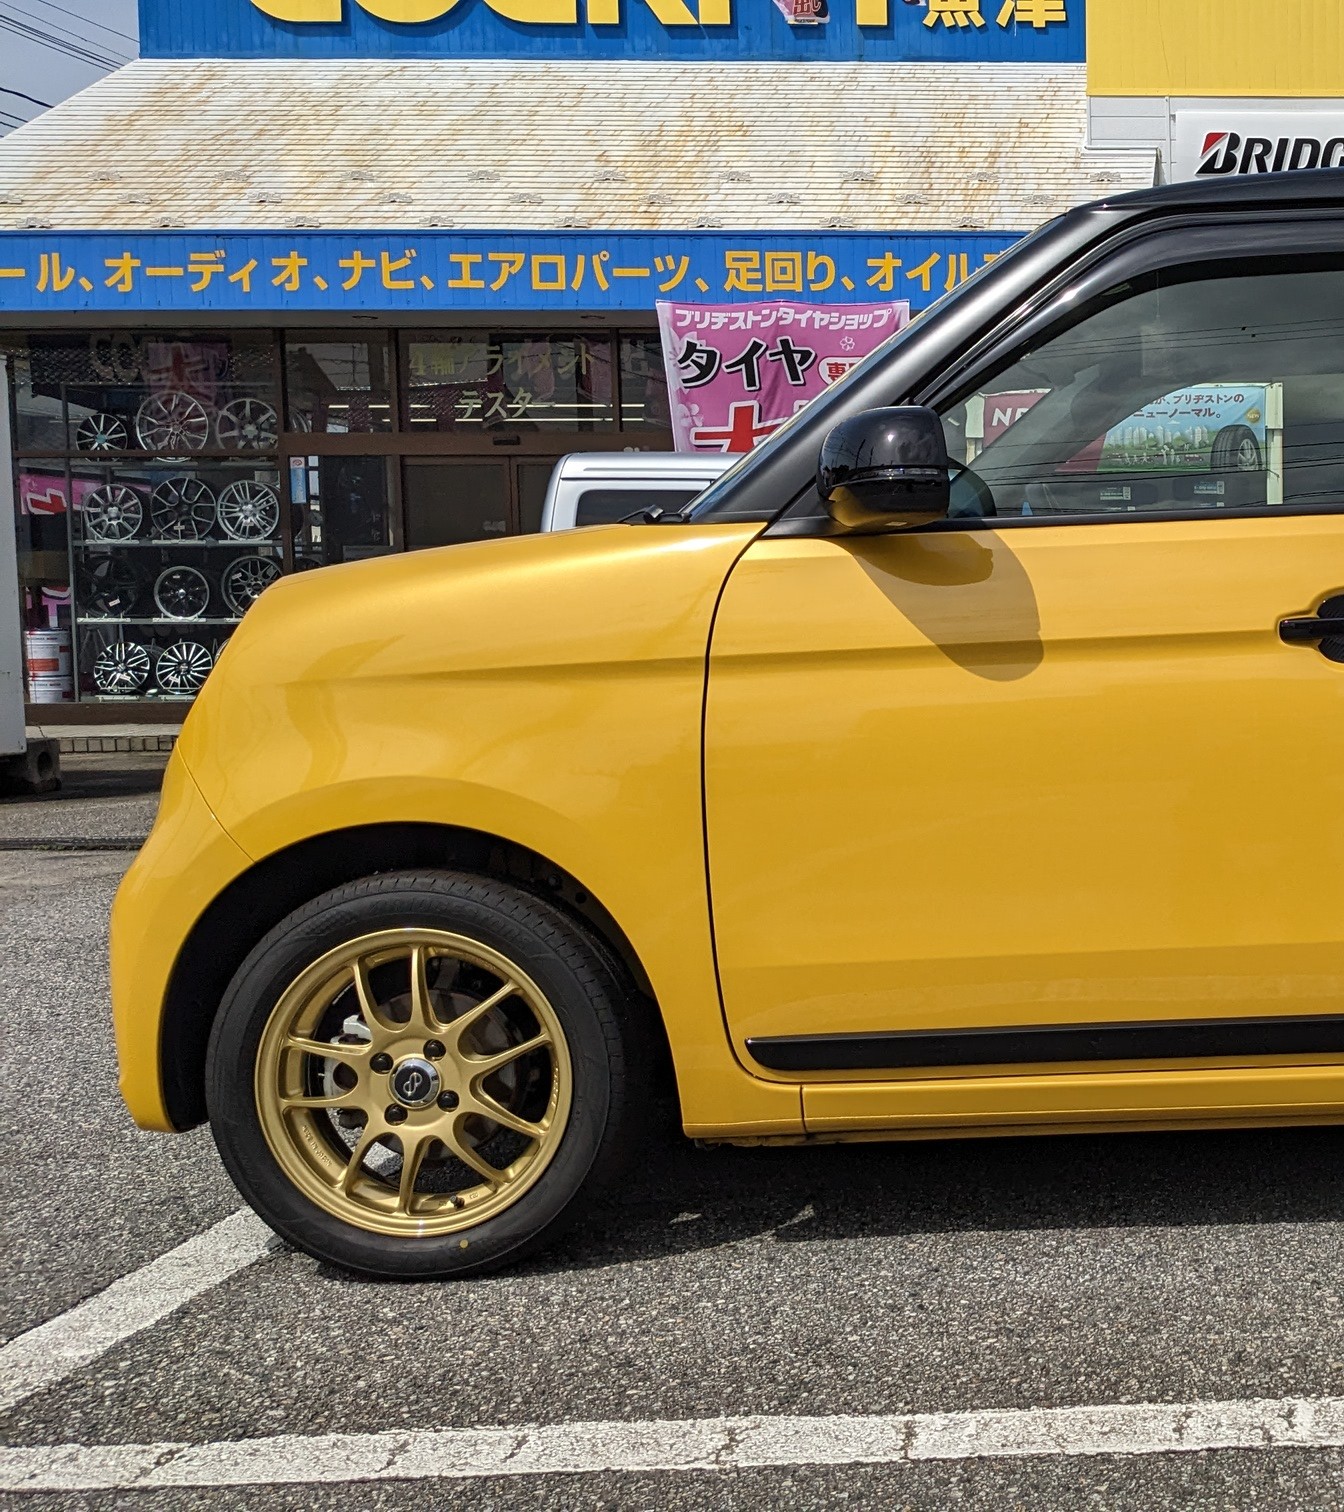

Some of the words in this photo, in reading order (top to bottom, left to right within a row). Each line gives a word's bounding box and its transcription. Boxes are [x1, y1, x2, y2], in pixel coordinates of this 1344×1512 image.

[0, 249, 1006, 293] ール、オーディオ、ナビ、エアロパーツ、足回り、オイル
[675, 307, 892, 331] ブリヂストンタイヤショップ
[677, 337, 817, 391] タイヤ
[458, 387, 556, 420] テスター
